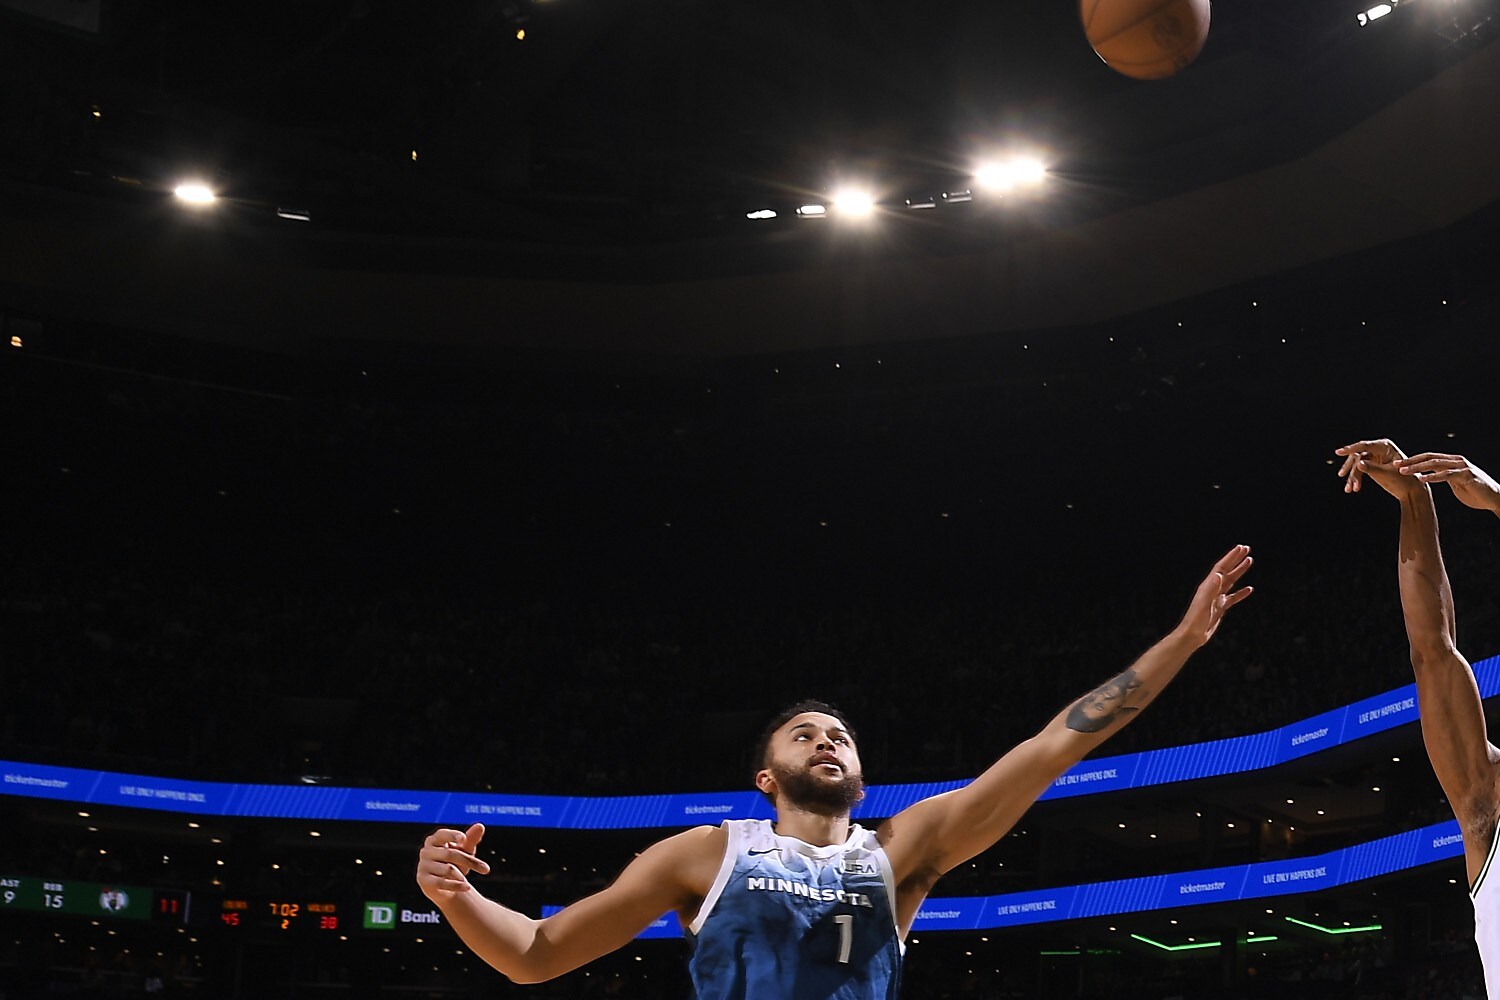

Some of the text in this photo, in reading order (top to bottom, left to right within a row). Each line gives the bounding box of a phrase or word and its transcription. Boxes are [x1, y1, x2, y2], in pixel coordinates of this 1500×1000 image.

[1292, 728, 1328, 746] ticketmaster
[1263, 873, 1275, 884] LIVE
[1276, 872, 1289, 883] ONLY
[748, 877, 874, 908] MINNESOTA
[1180, 882, 1225, 893] ticketmaster
[4, 891, 15, 903] 9
[45, 894, 64, 908] 15
[161, 899, 178, 913] 11
[269, 903, 299, 917] 7:02
[221, 913, 240, 926] 45
[368, 906, 440, 924] TD Bank
[916, 910, 961, 920] cketmaster
[835, 914, 854, 964] 1
